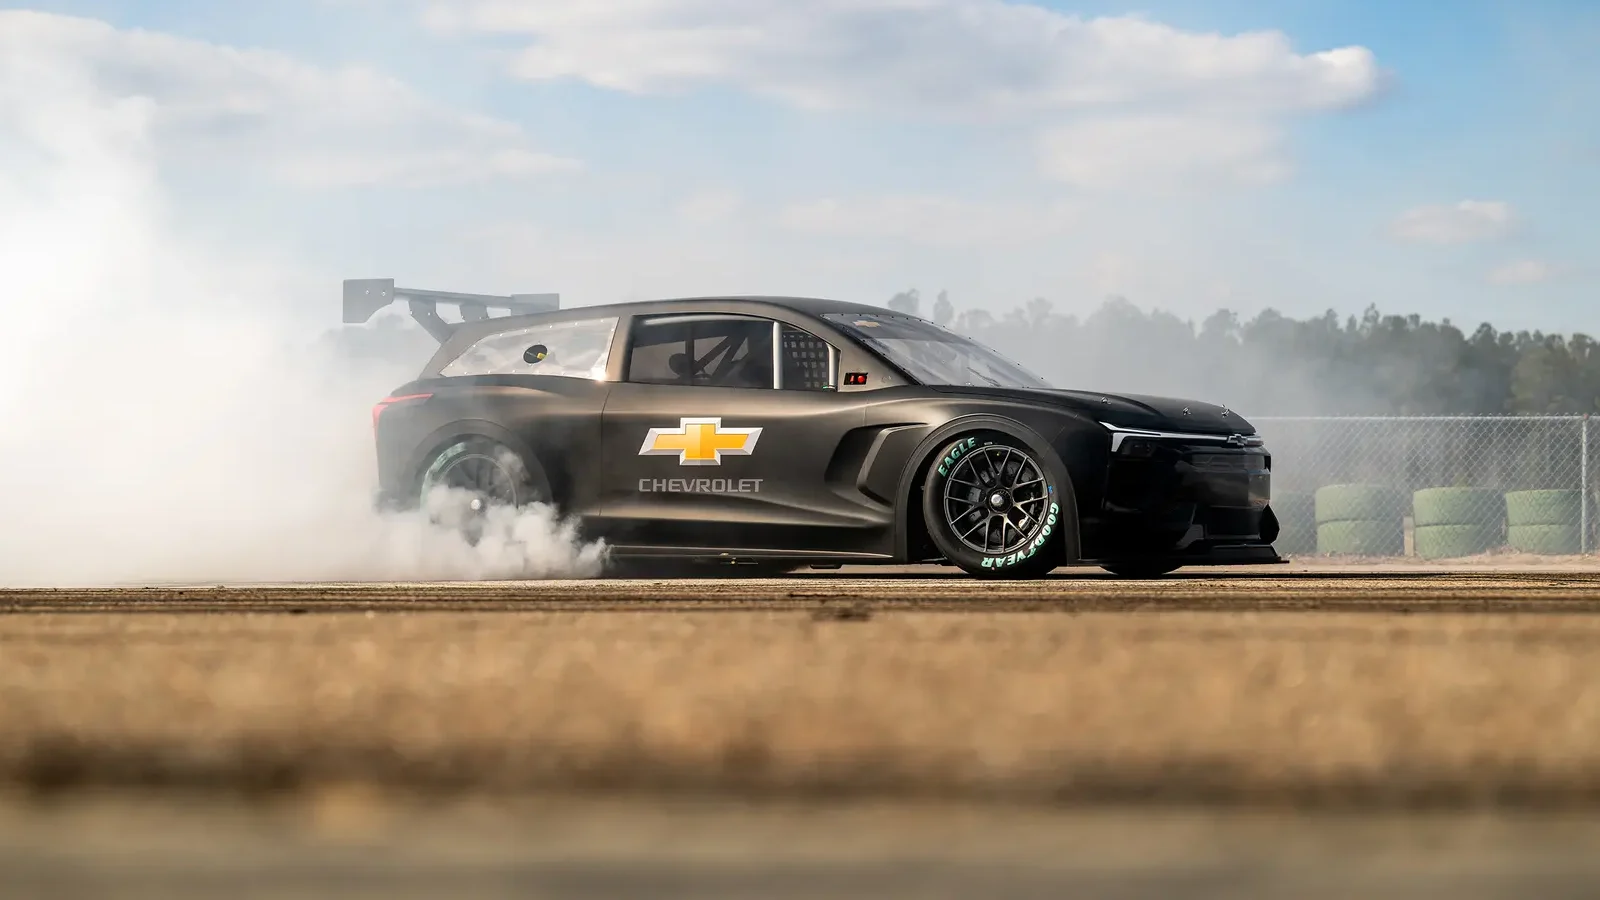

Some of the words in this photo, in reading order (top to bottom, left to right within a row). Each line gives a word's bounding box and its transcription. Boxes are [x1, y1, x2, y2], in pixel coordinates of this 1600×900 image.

[937, 437, 977, 477] EAGLE
[638, 478, 763, 493] CHEVROLET
[981, 502, 1060, 568] GOODYEAR
